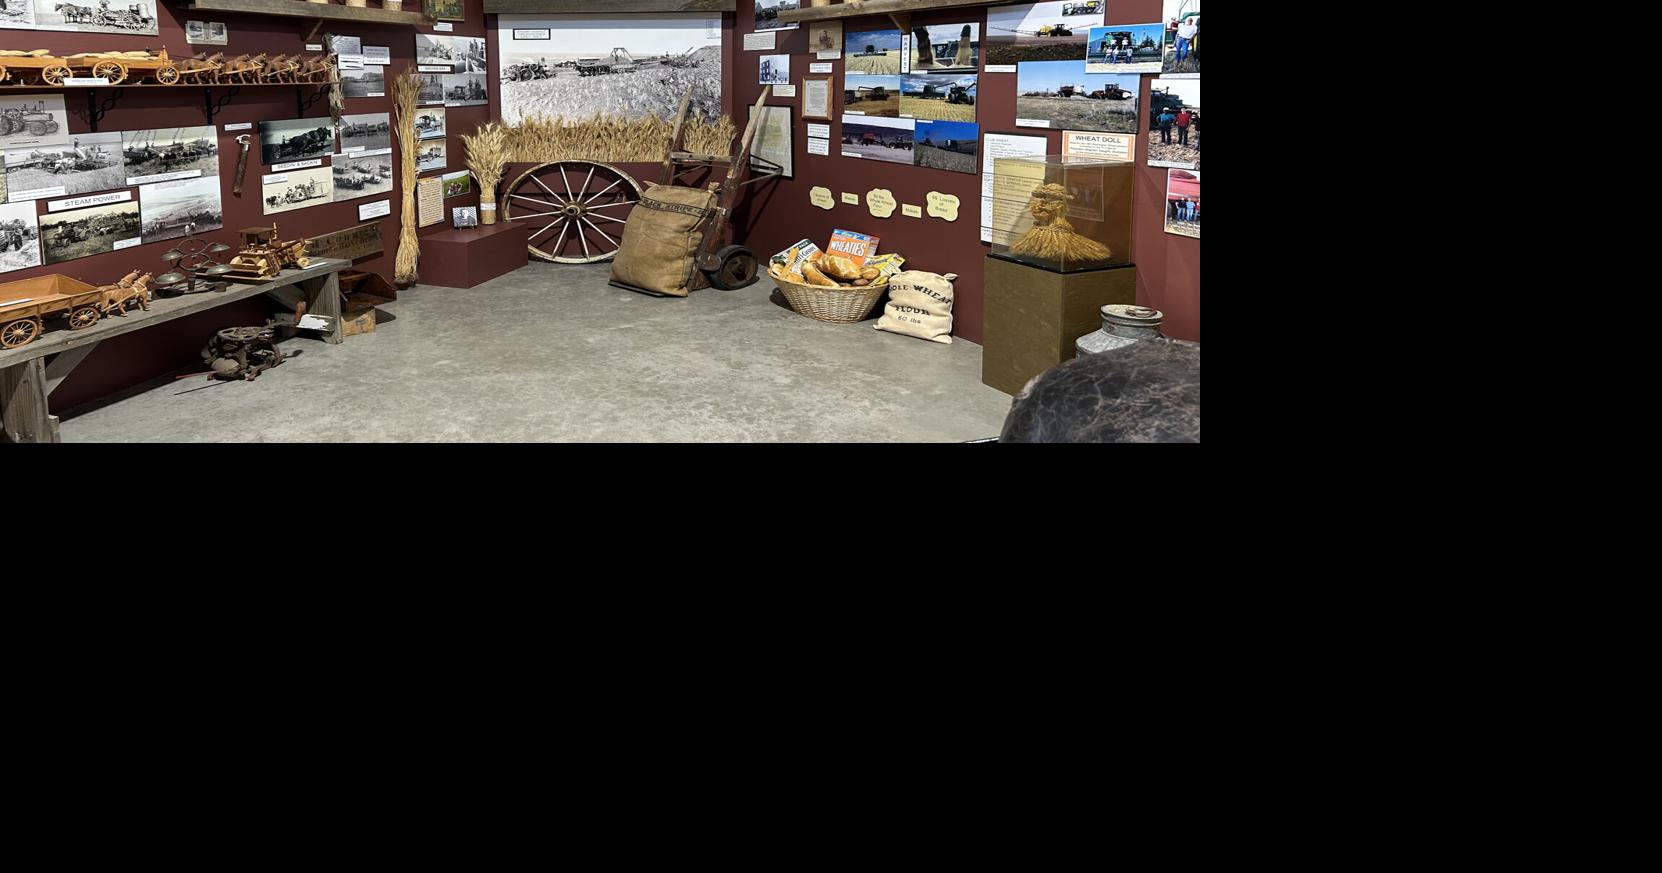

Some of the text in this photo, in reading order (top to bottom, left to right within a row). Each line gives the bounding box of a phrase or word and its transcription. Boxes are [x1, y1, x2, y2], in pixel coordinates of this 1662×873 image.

[1102, 136, 1121, 144] DOLL
[64, 194, 121, 207] STEAM POWER
[830, 240, 865, 257] WHEATIES
[894, 305, 931, 316] FLOUR
